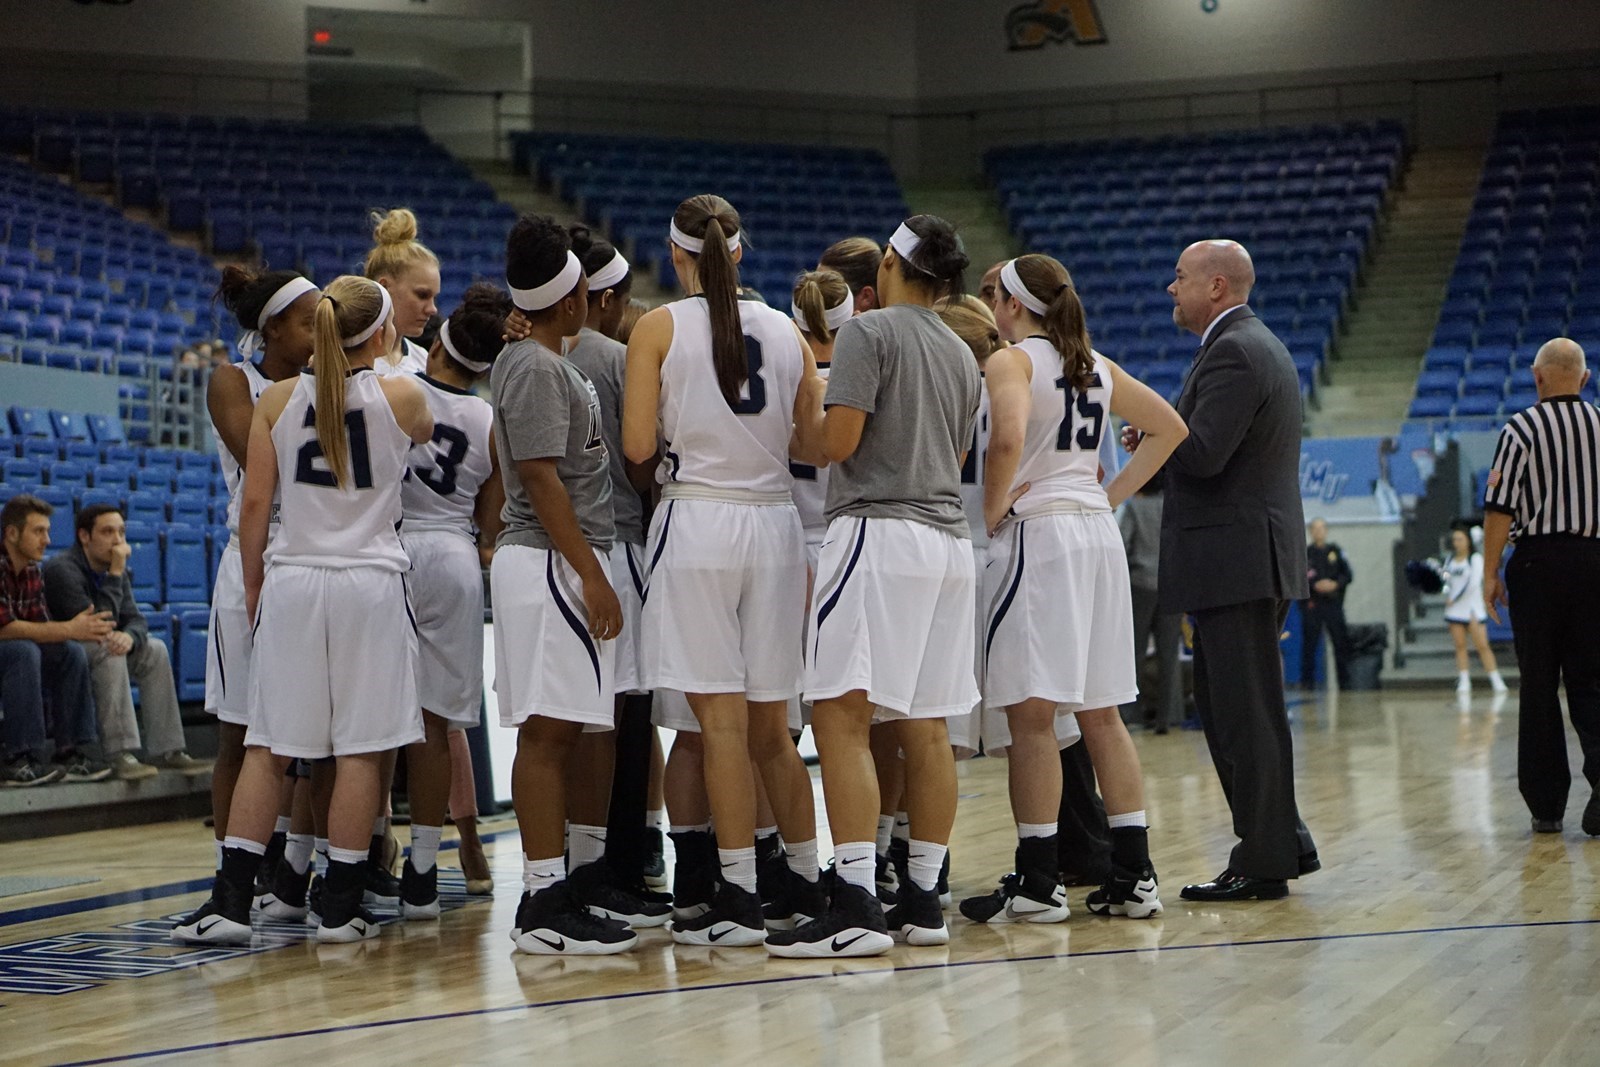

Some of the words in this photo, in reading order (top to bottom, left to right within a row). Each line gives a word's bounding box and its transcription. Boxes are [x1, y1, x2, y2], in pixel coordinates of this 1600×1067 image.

[294, 401, 373, 489] 21
[1054, 372, 1103, 452] 15
[401, 422, 470, 496] 3
